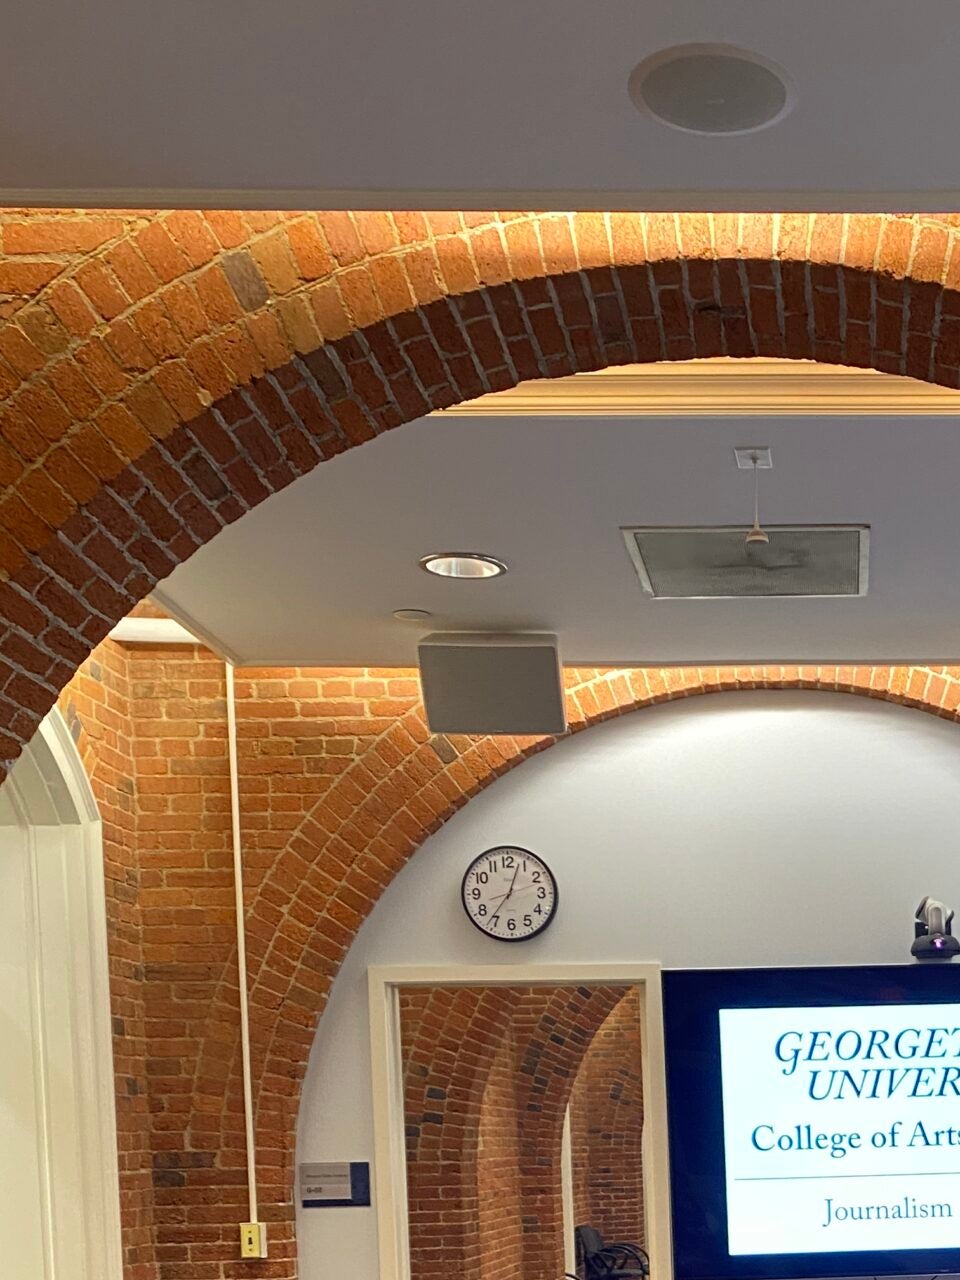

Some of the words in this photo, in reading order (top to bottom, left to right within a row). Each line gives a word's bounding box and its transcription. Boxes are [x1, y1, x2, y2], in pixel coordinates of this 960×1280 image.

[489, 860, 497, 872] 11
[502, 856, 514, 868] 12
[476, 872, 488, 884] 10
[532, 871, 540, 883] 2
[472, 888, 480, 900] 9
[537, 887, 546, 899] 3
[478, 904, 487, 916] 8
[534, 904, 542, 915] 4
[492, 916, 500, 927] 7
[507, 919, 516, 930] 6
[523, 915, 532, 927] 5
[751, 1124, 862, 1158] College
[871, 1121, 902, 1148] of
[822, 1197, 953, 1227] Journalism
